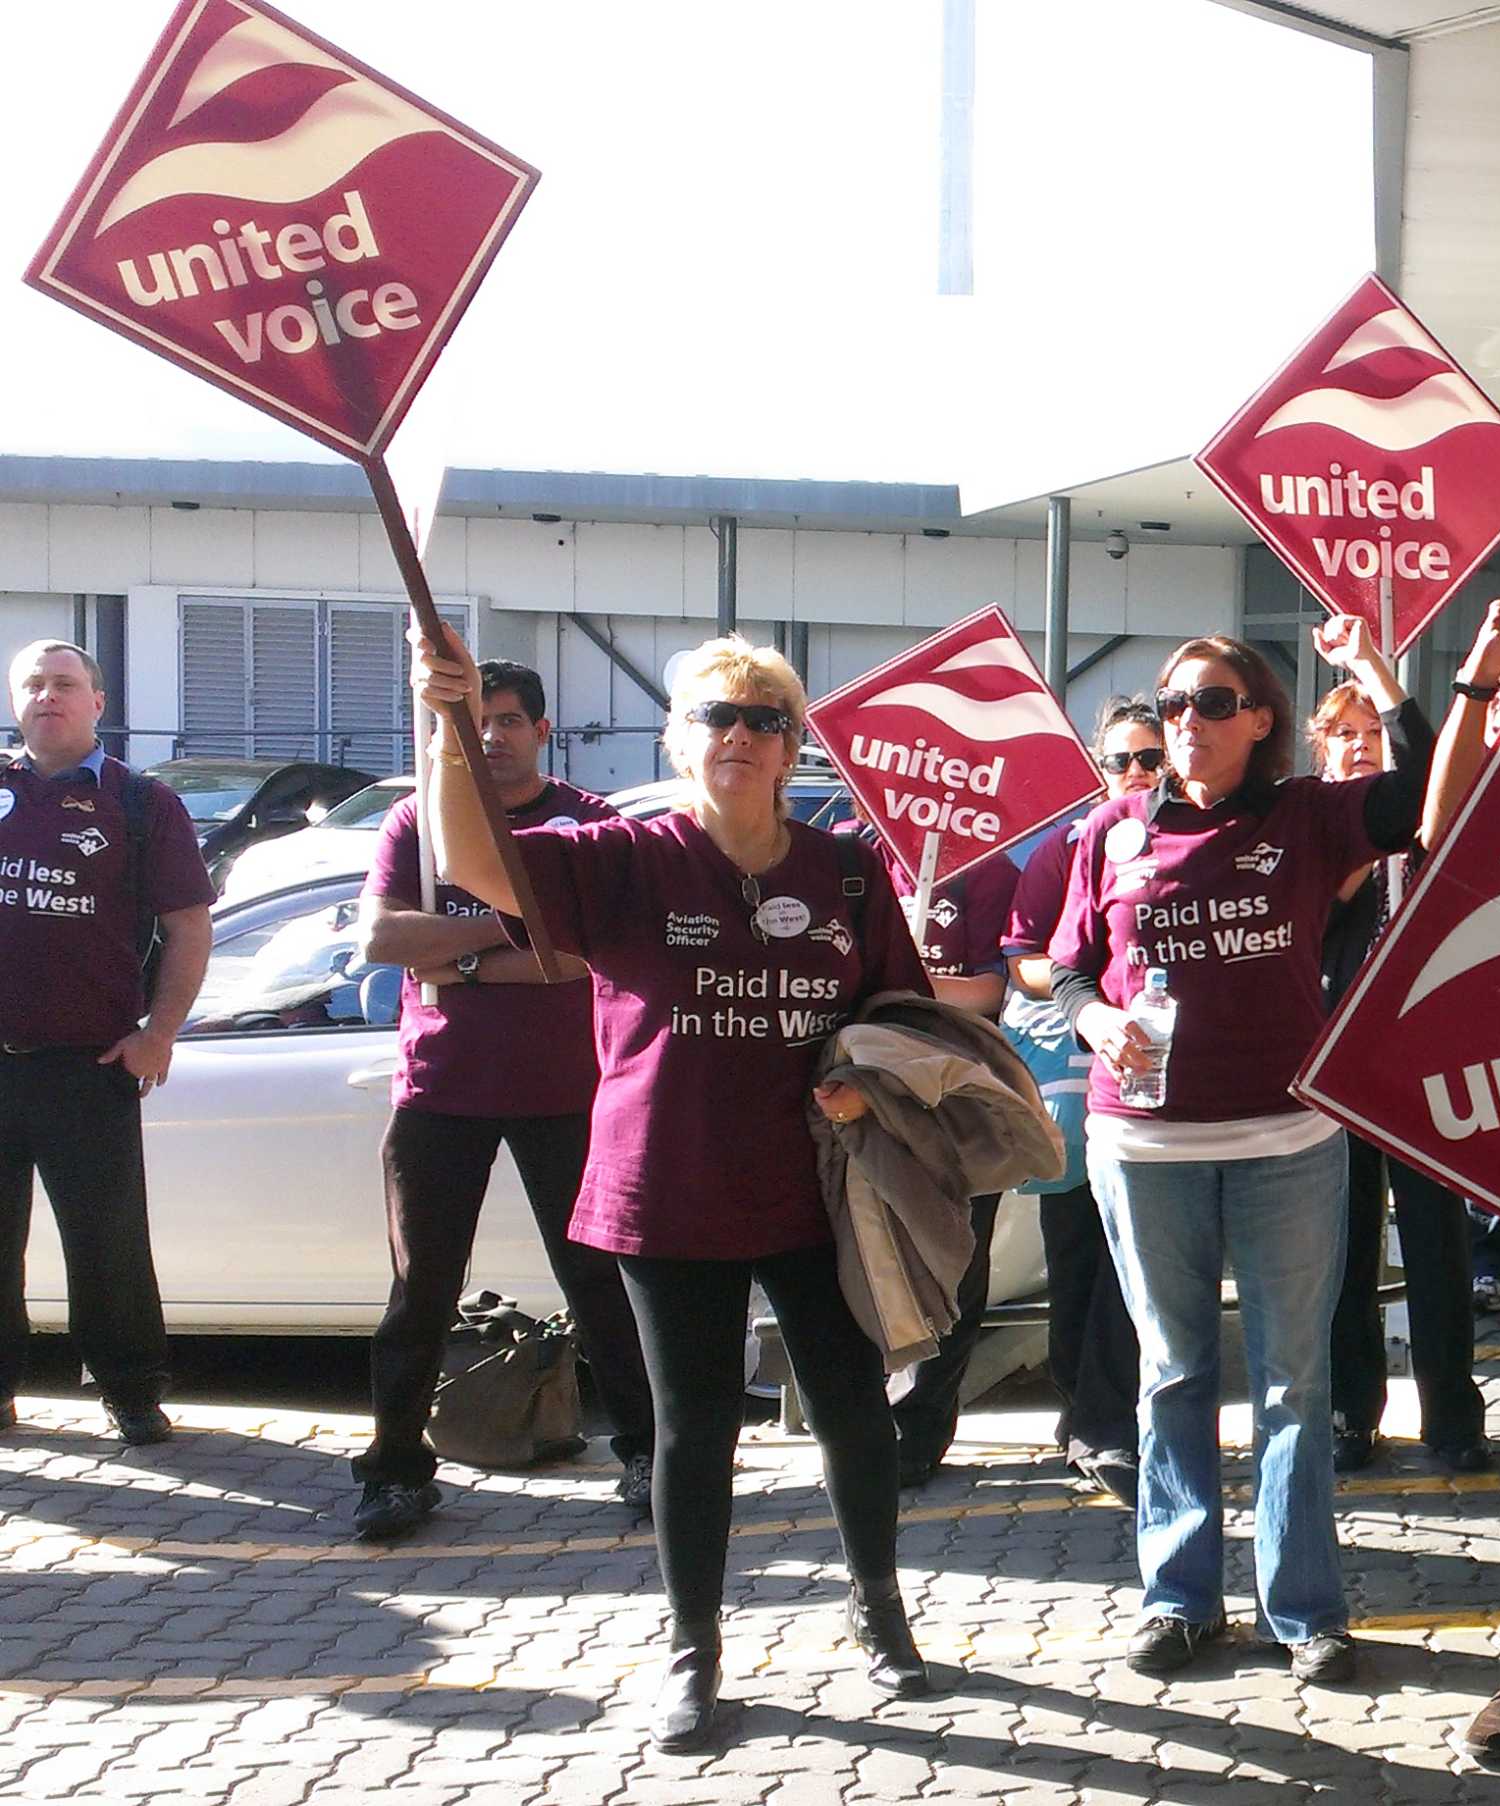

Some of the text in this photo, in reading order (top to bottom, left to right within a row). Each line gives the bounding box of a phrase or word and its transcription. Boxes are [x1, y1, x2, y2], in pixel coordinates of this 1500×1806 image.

[117, 190, 380, 306] united
[214, 280, 421, 364] voice
[1260, 462, 1436, 522] united
[1311, 526, 1451, 582] voice
[849, 734, 1005, 798] united
[883, 790, 1002, 843] voice
[0, 856, 77, 886] id less
[25, 887, 96, 915] West!
[666, 910, 721, 927] Aviation
[1135, 894, 1270, 931] Paid less
[665, 922, 720, 939] Security
[665, 934, 711, 947] Officer
[1154, 935, 1207, 964] the
[1212, 920, 1293, 958] West!
[919, 944, 943, 960] ss
[696, 967, 841, 1000] Paid less
[671, 1005, 702, 1036] in
[711, 1006, 769, 1038] the
